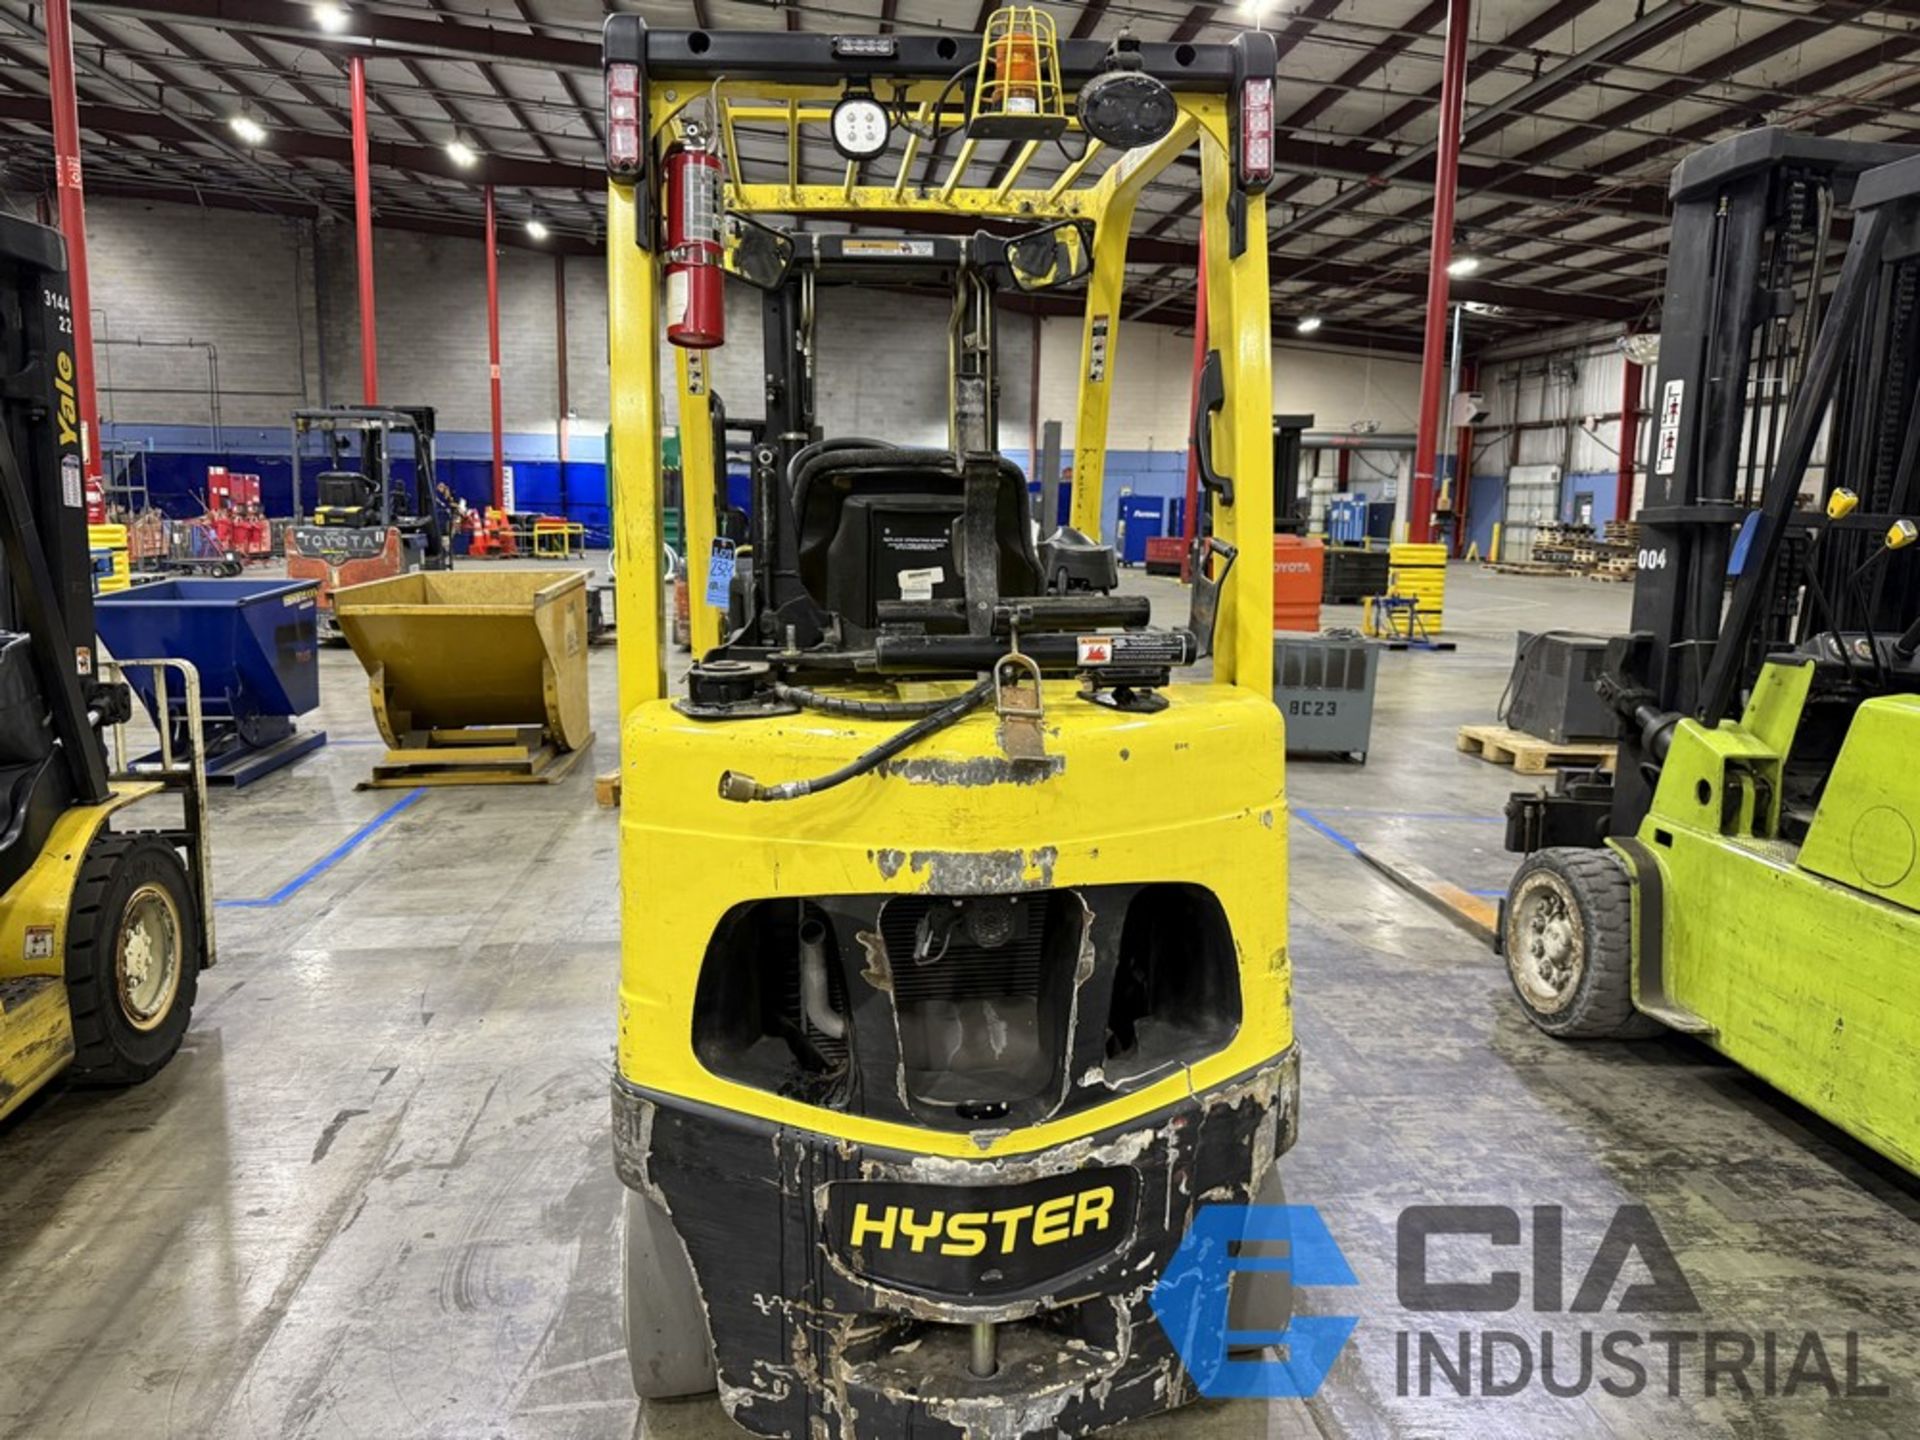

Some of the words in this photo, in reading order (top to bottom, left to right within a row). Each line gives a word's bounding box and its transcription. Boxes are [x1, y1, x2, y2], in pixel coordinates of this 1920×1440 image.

[44, 289, 70, 314] 3144
[58, 316, 73, 334] 22
[55, 351, 77, 445] Yale
[303, 534, 375, 549] TOYOTA
[1274, 562, 1311, 573] OYOTA
[1638, 549, 1666, 569] 004
[850, 1185, 1115, 1257] HYSTER
